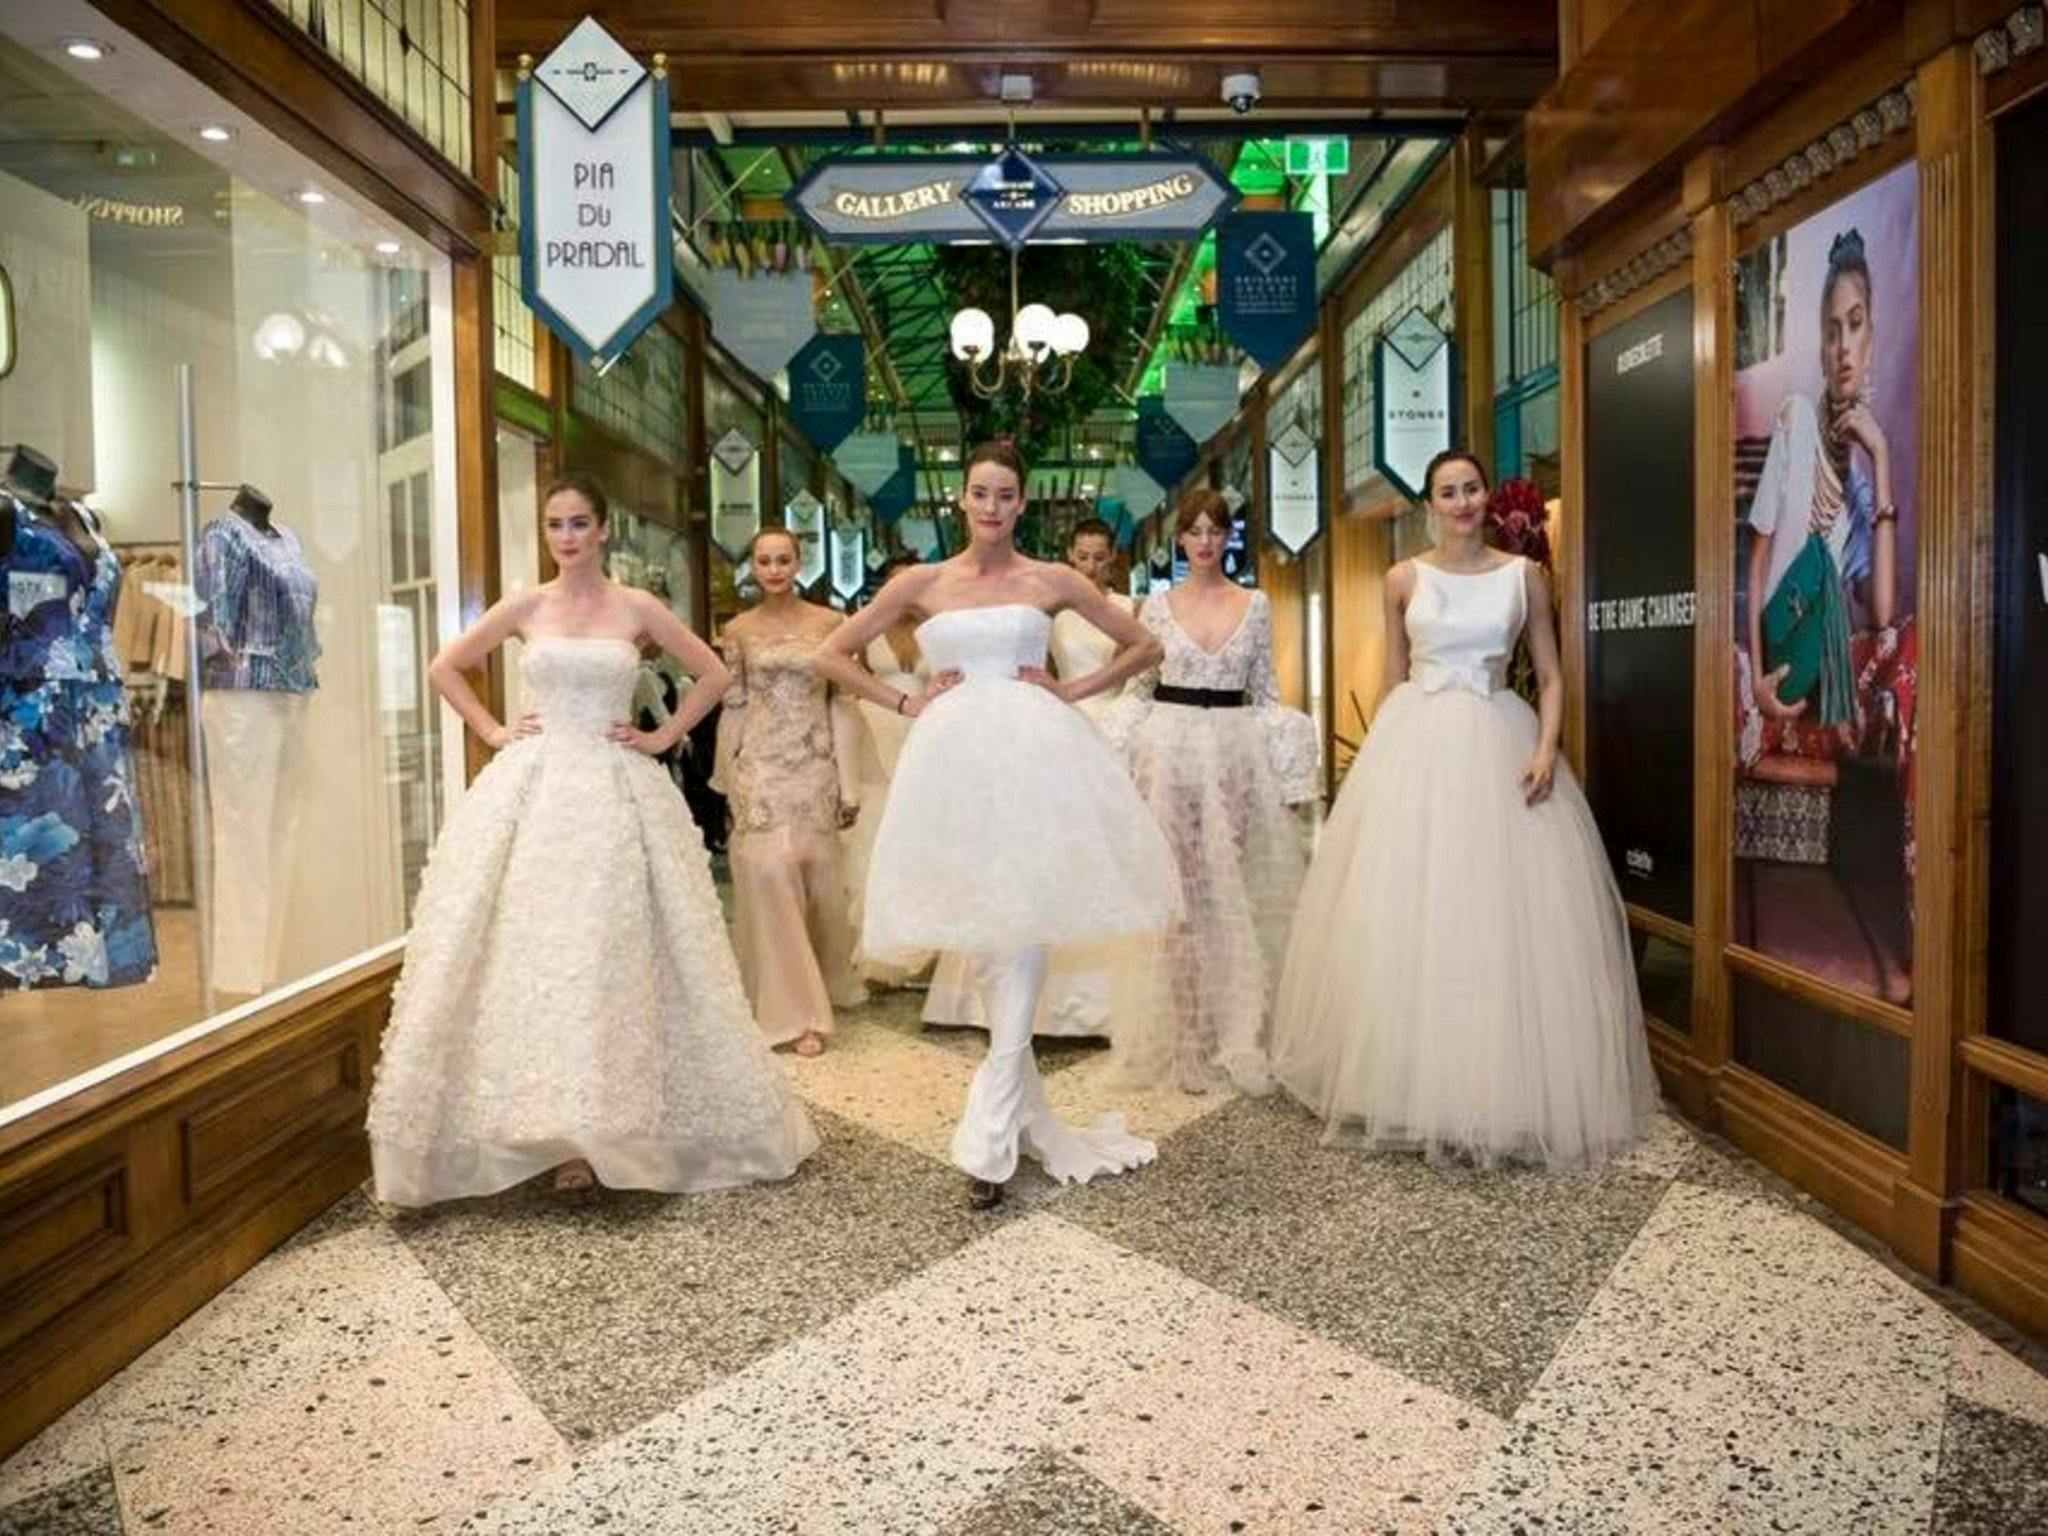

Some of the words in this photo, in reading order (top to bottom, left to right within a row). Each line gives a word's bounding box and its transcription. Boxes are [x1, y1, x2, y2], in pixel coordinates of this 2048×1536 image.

[573, 163, 614, 190] PIA
[835, 181, 953, 218] GALLERY
[1068, 171, 1194, 216] SHOPPING
[547, 241, 645, 268] PRADAL
